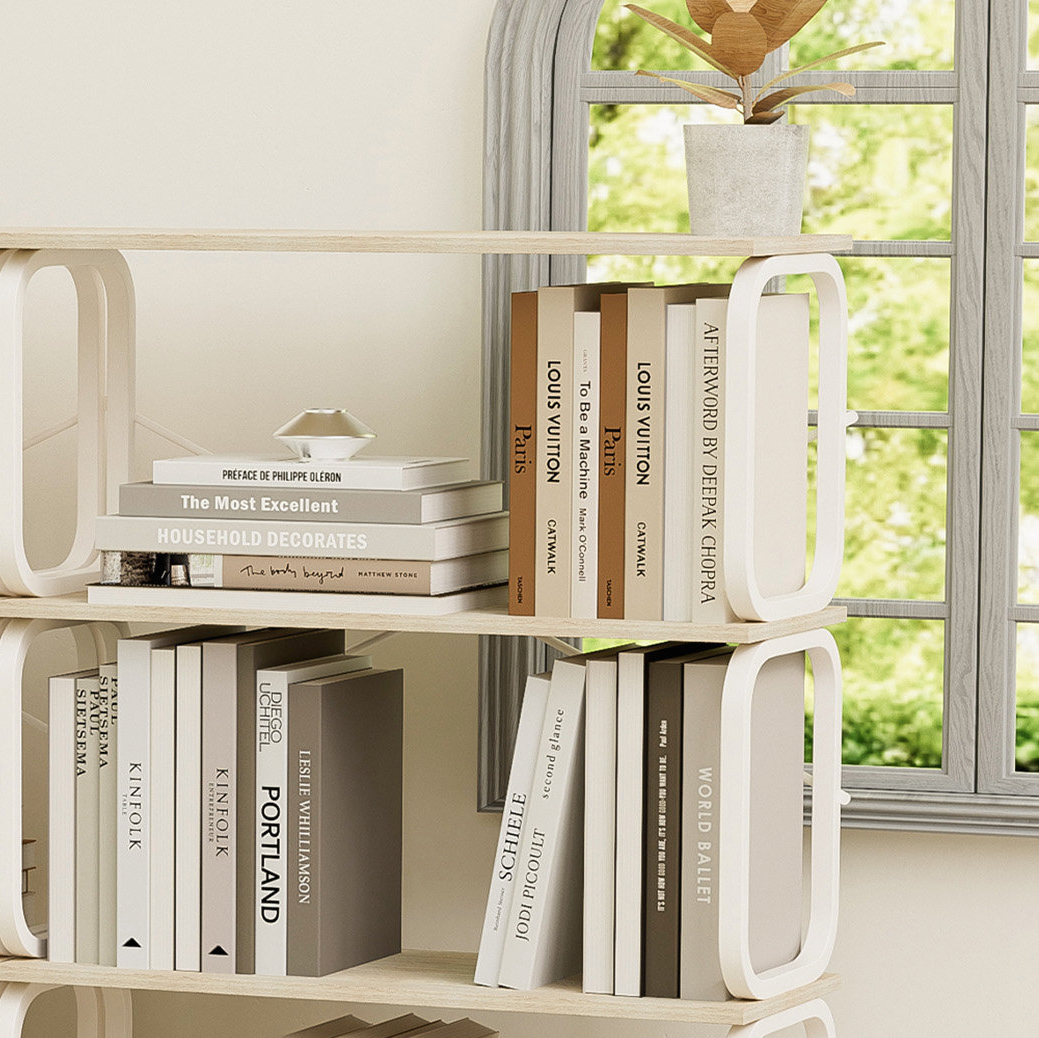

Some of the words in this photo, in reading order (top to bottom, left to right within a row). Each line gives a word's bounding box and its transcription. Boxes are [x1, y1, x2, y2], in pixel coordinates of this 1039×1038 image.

[548, 361, 561, 409] LOUIS
[580, 381, 590, 397] To
[703, 323, 718, 430] AFTERWORD
[580, 403, 590, 421] Be
[223, 468, 257, 480] PRÉFACE
[260, 471, 269, 480] DE
[273, 471, 307, 481] PHILIPPE
[310, 468, 341, 482] OLÉRON
[515, 426, 531, 473] Paris
[547, 415, 560, 482] VUITTON
[580, 440, 590, 499] Machine
[703, 438, 717, 459] BY
[181, 495, 209, 509] The
[215, 496, 256, 510] Most
[261, 498, 338, 513] Excellent
[702, 465, 717, 528] DEEPAK
[158, 529, 261, 545] HOUSEHOLD
[268, 532, 367, 549] DECORATES
[548, 520, 556, 573] CATWALK
[701, 536, 716, 603] CHOPRA
[259, 683, 272, 752] UCHITEL
[271, 692, 282, 744] DIEGO
[300, 751, 310, 795] LESLIE
[542, 754, 557, 799] second
[550, 709, 564, 751] glance
[129, 763, 141, 849] KINFOLK
[216, 769, 228, 856] KINFOLK
[698, 768, 712, 832] WORLD
[261, 787, 280, 923] PORTLAND
[299, 801, 310, 903] WHILLIAMSON
[499, 792, 527, 882] SCHIELE
[523, 828, 547, 900] PICOULT
[697, 842, 711, 904] BALLET
[515, 904, 532, 942] JODI
